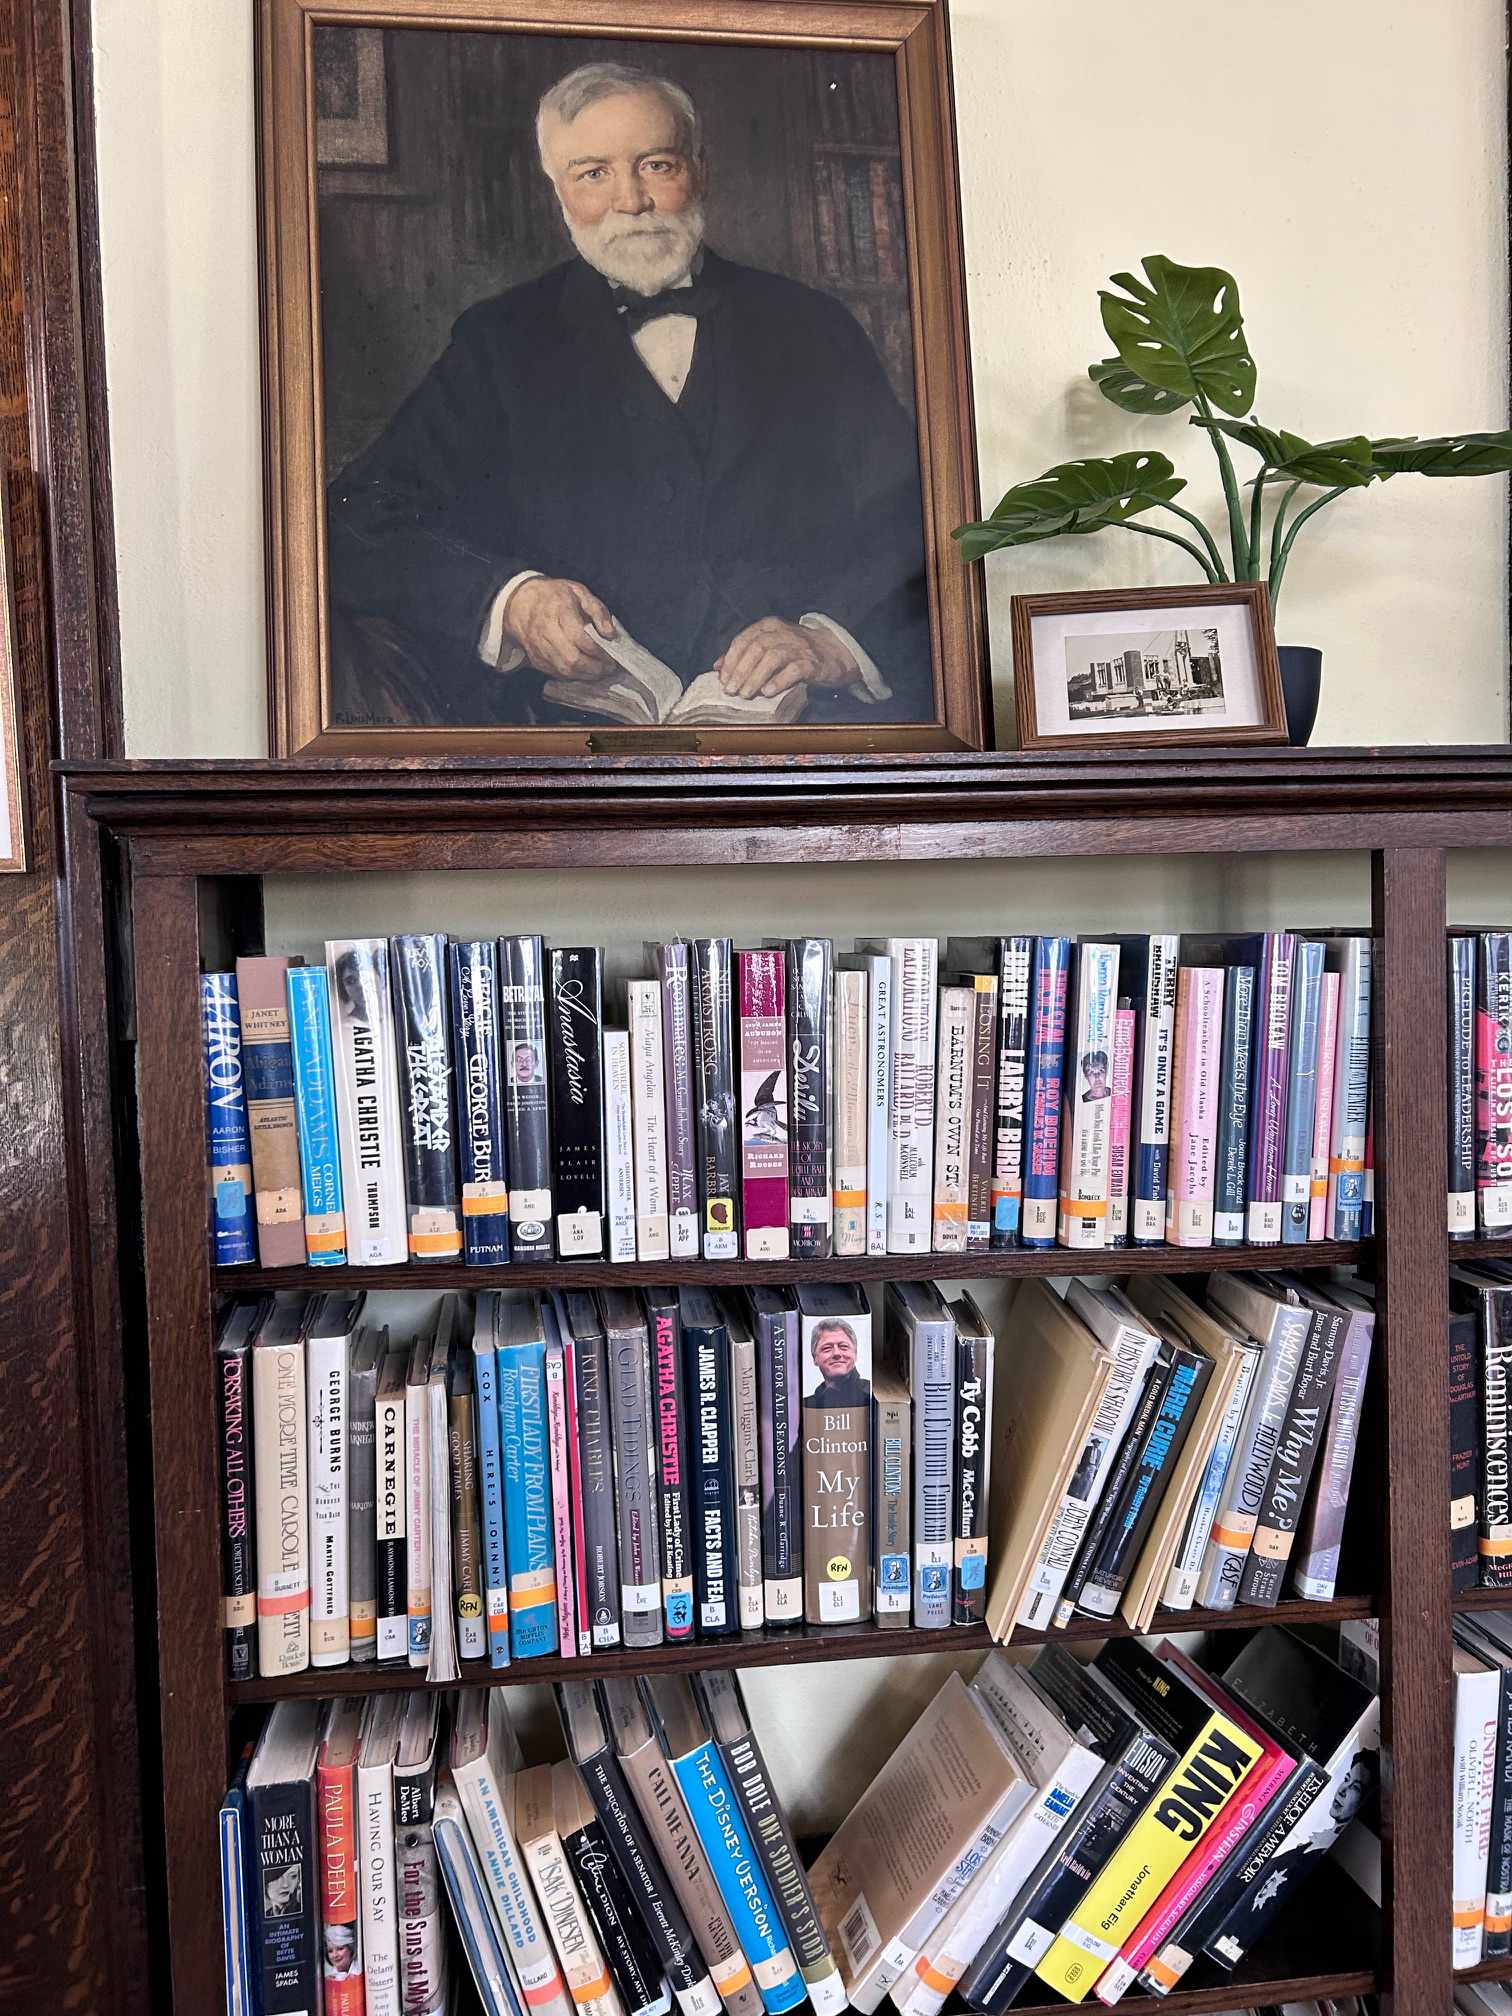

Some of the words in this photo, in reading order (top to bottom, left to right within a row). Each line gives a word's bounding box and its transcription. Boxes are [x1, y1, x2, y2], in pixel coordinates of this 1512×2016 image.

[878, 981, 886, 1019] GREAT
[1163, 956, 1176, 1008] TERRY
[1241, 975, 1254, 1008] More
[1498, 973, 1509, 1023] KERIK
[245, 1021, 286, 1030] WHITNEY
[251, 1009, 279, 1019] JANET
[1240, 1010, 1251, 1041] Than
[1461, 977, 1472, 1050] PRELUDE
[644, 1029, 655, 1056] Maya
[977, 1004, 992, 1066] LOSING
[1160, 1028, 1168, 1051] IT'S
[354, 1026, 376, 1088] AGATHA
[876, 1023, 885, 1108] ASTRONOMERS
[1157, 1056, 1167, 1085] ONLY
[1237, 1044, 1250, 1081] Meets
[1461, 1053, 1470, 1063] TO
[646, 1061, 656, 1099] Angelou
[977, 1074, 988, 1090] IT
[998, 1049, 1025, 1128] LARRY
[1046, 1078, 1062, 1110] ROY
[1237, 1082, 1247, 1103] the
[358, 1096, 381, 1169] CHRISTIE
[1154, 1101, 1164, 1135] GAME
[1228, 1101, 1247, 1128] Eye
[1461, 1068, 1475, 1170] LEADERSHIP
[997, 1128, 1021, 1178] BIRD
[1044, 1113, 1060, 1176] BOEHM
[1202, 1138, 1210, 1170] Edited
[311, 1165, 322, 1207] MEIGS
[719, 1173, 729, 1193] JAY
[1200, 1173, 1209, 1188] by
[1237, 1160, 1245, 1185] Brock
[366, 1183, 378, 1228] THOMPSON
[470, 1245, 503, 1254] PUTNAM
[774, 1326, 784, 1339] A
[1313, 1311, 1328, 1330] Jane
[1326, 1316, 1343, 1349] Sammy
[656, 1314, 675, 1397] AGATHA
[774, 1340, 784, 1362] SPY
[1123, 1331, 1146, 1349] IN
[1310, 1331, 1323, 1351] and
[276, 1352, 293, 1390] ONE
[581, 1354, 600, 1402] KING
[698, 1344, 714, 1393] JAMES
[775, 1366, 785, 1388] FOR
[1105, 1343, 1144, 1396] HISTORY'S
[1304, 1351, 1318, 1372] Burt
[1318, 1350, 1333, 1378] Davis,
[329, 1371, 340, 1423] GEORGE
[482, 1372, 490, 1402] COX
[520, 1364, 541, 1417] FIRST
[700, 1394, 714, 1407] R.
[741, 1367, 753, 1399] Mary
[962, 1380, 981, 1404] Ty
[1160, 1364, 1198, 1421] MARIE
[1296, 1373, 1312, 1399] Boyar
[1315, 1378, 1326, 1391] Jr.
[279, 1394, 297, 1446] MORE
[775, 1393, 786, 1415] ALL
[1093, 1391, 1126, 1436] SHADOW
[522, 1419, 544, 1457] LADY
[701, 1406, 719, 1465] CLAPPER
[741, 1402, 755, 1450] Higgins
[824, 1415, 850, 1431] Bill
[963, 1407, 982, 1458] Cobb
[1278, 1402, 1319, 1467] Why
[330, 1427, 341, 1473] BURNS
[585, 1409, 603, 1494] CHARLES
[659, 1397, 680, 1486] CHRISTIE
[776, 1419, 786, 1477] SEASONS
[806, 1438, 867, 1454] Clinton
[1142, 1419, 1177, 1471] CURIE
[279, 1449, 298, 1490] TIME
[384, 1407, 396, 1535] CARNEGIE
[464, 1440, 473, 1490] SHARING
[486, 1449, 496, 1506] HERE'S
[743, 1448, 754, 1483] Clark
[1239, 1425, 1277, 1507] HOLLYWOOD
[525, 1460, 546, 1515] FROM
[818, 1471, 860, 1500] My
[962, 1468, 972, 1538] McCallum
[1267, 1471, 1302, 1530] Me?
[280, 1495, 299, 1572] CAROLE
[704, 1509, 721, 1551] FACTS
[812, 1505, 864, 1529] Life
[326, 1535, 334, 1566] MARTIN
[459, 1528, 469, 1563] JIMMY
[489, 1520, 499, 1586] JOHNNY
[528, 1515, 551, 1572] PLAINS
[596, 1545, 604, 1573] ROBERT
[706, 1551, 722, 1578] AND
[831, 1562, 848, 1572] RFN
[326, 1567, 334, 1615] GOTTFRIED
[598, 1576, 606, 1602] JOBSON
[730, 1742, 757, 1773] BOB
[1125, 1739, 1169, 1783] EDISON
[1480, 1719, 1497, 1800] UNDER
[411, 1787, 420, 1820] Albert
[477, 1777, 490, 1795] AN
[743, 1775, 771, 1813] DOLE
[1110, 1782, 1139, 1806] CENTURY
[1123, 1781, 1136, 1793] THE
[1153, 1728, 1253, 1843] KING
[264, 1814, 296, 1829] MORE
[325, 1783, 345, 1855] PAULA
[368, 1791, 382, 1852] HAVING
[400, 1786, 409, 1822] DeMeo
[261, 1833, 289, 1848] THAN
[290, 1832, 300, 1845] A
[483, 1800, 513, 1866] AMERICAN
[594, 1765, 608, 1785] THE
[604, 1785, 630, 1833] EDUCATION
[624, 1834, 635, 1847] OF
[634, 1856, 654, 1892] SENATOR
[694, 1752, 719, 1789] THE
[708, 1789, 746, 1859] DISNEY
[734, 1861, 774, 1936] VERSION
[757, 1814, 783, 1844] ONE
[1478, 1807, 1493, 1859] FIRE
[260, 1847, 304, 1865] WOMAN
[370, 1857, 384, 1891] OUR
[403, 1860, 426, 1886] For
[327, 1855, 347, 1908] DEEN
[486, 1850, 506, 1889] ANNIE
[500, 1895, 525, 1948] DILLARD
[580, 1850, 615, 1895] Celine
[600, 1894, 617, 1926] DION
[768, 1848, 809, 1918] SOLDIER'S
[1121, 1864, 1151, 1908] Jonathan
[373, 1897, 386, 1922] SAY
[406, 1891, 422, 1917] the
[506, 1873, 537, 1942] CHILDHOOD
[1100, 1909, 1120, 1931] Eig
[269, 1928, 299, 1938] INTIMATE
[406, 1921, 428, 1956] Sins
[795, 1921, 826, 1964] STORY
[275, 1970, 298, 1979] JAMES
[372, 1953, 389, 1962] The
[407, 1959, 423, 1978] of
[275, 1978, 298, 1988] SPADA
[408, 1980, 429, 2005] My
